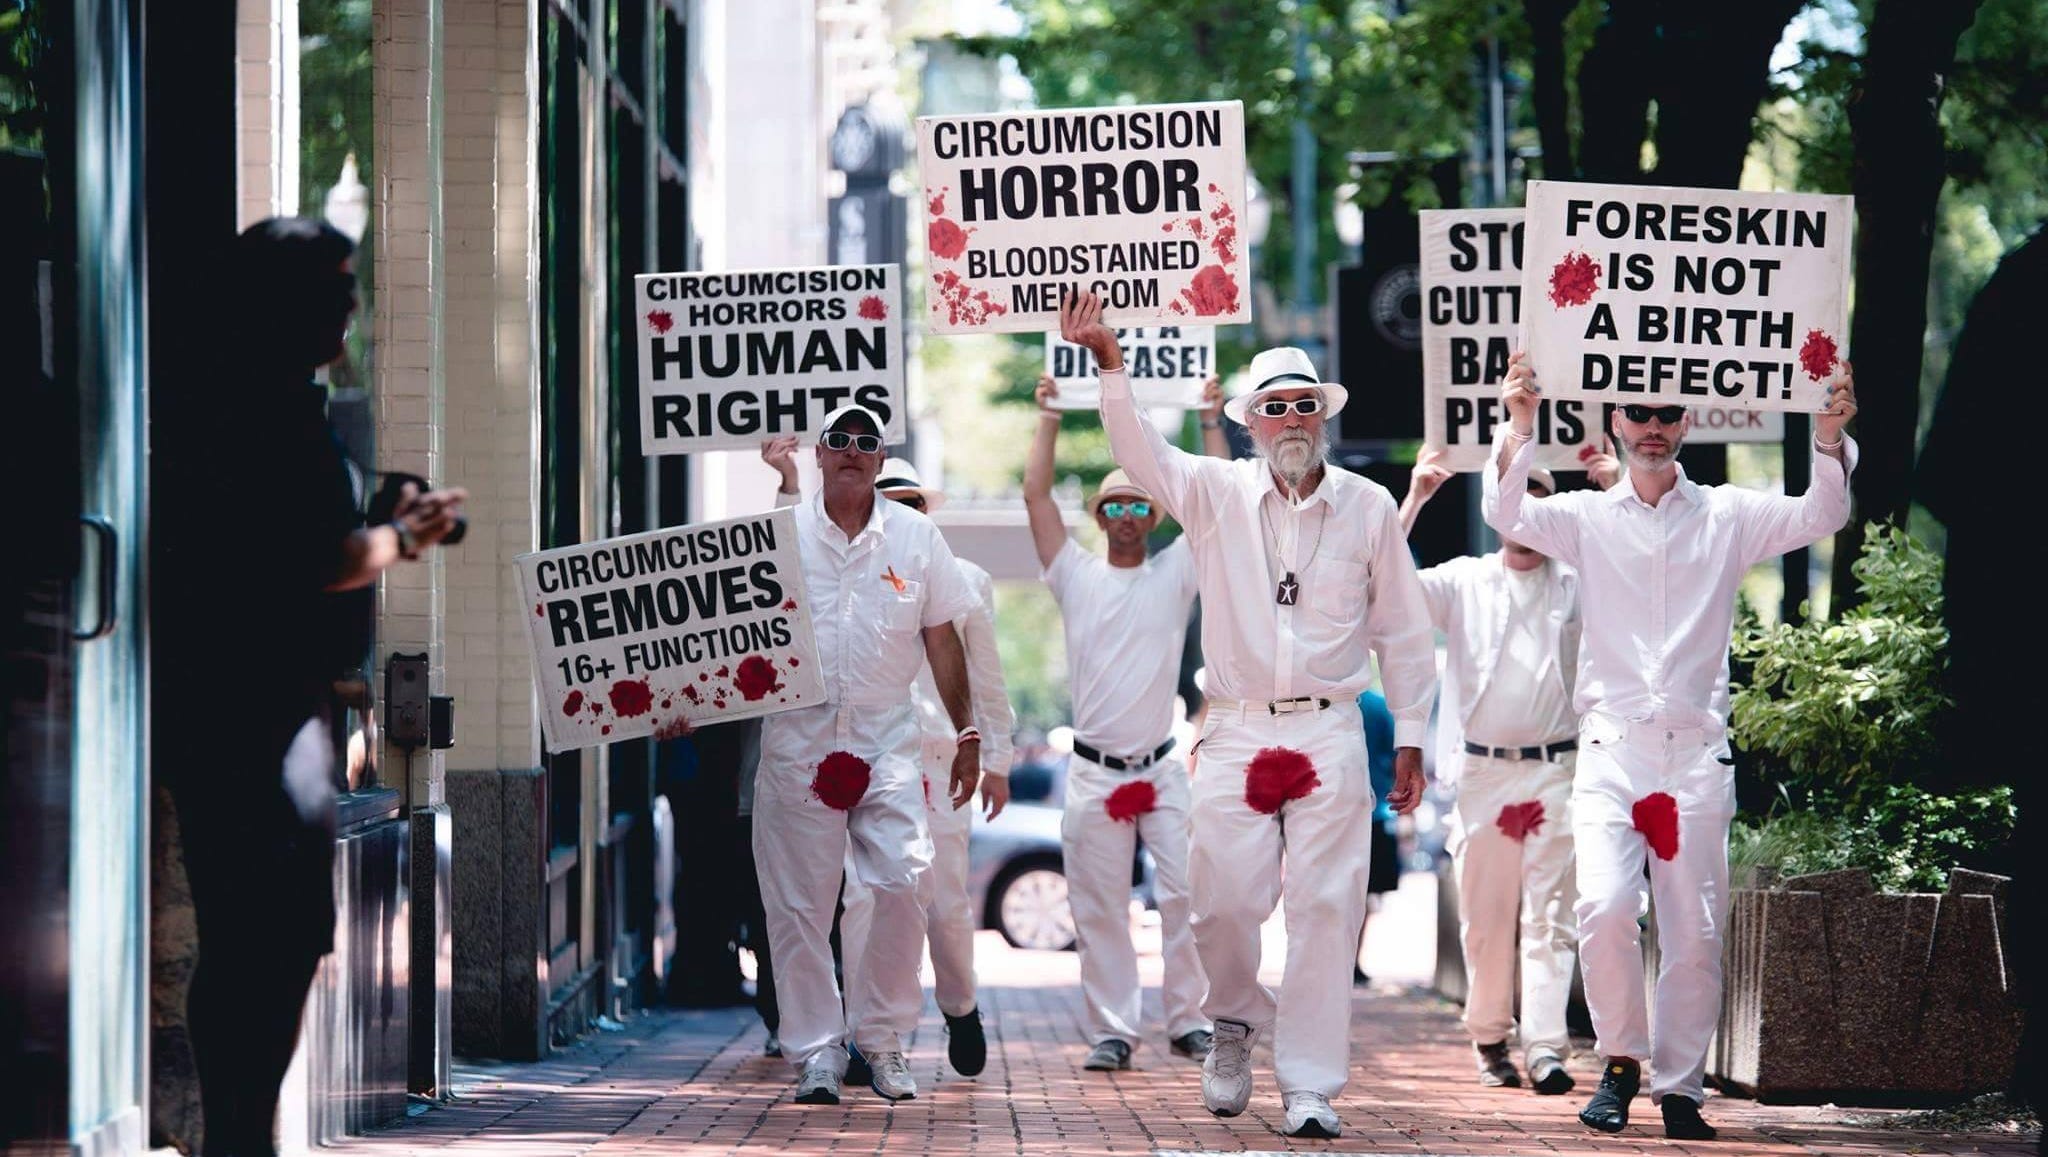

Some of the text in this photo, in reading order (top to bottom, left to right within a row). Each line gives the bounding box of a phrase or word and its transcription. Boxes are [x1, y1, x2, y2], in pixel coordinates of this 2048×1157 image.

[934, 110, 1221, 160] CIRCUMCISION
[960, 159, 1201, 222] HORROR
[1565, 200, 1827, 248] FORESKIN
[967, 240, 1200, 279] BLOODSTAINED
[1607, 253, 1781, 297] IS NOT
[646, 268, 886, 301] CIRCUMCISION
[689, 298, 847, 327] HORRORS
[1584, 303, 1794, 349] A BIRTH
[651, 327, 887, 381] HUMAN
[1054, 346, 1209, 379] DIASE!
[1582, 353, 1794, 400] DEFECT!
[653, 385, 892, 439] RIGHTS
[1689, 408, 1764, 429] LOCK
[537, 518, 776, 594] CIRCUMCISION
[547, 560, 784, 647] REMOVES
[557, 616, 792, 687] 16+ FUNCTIONS
